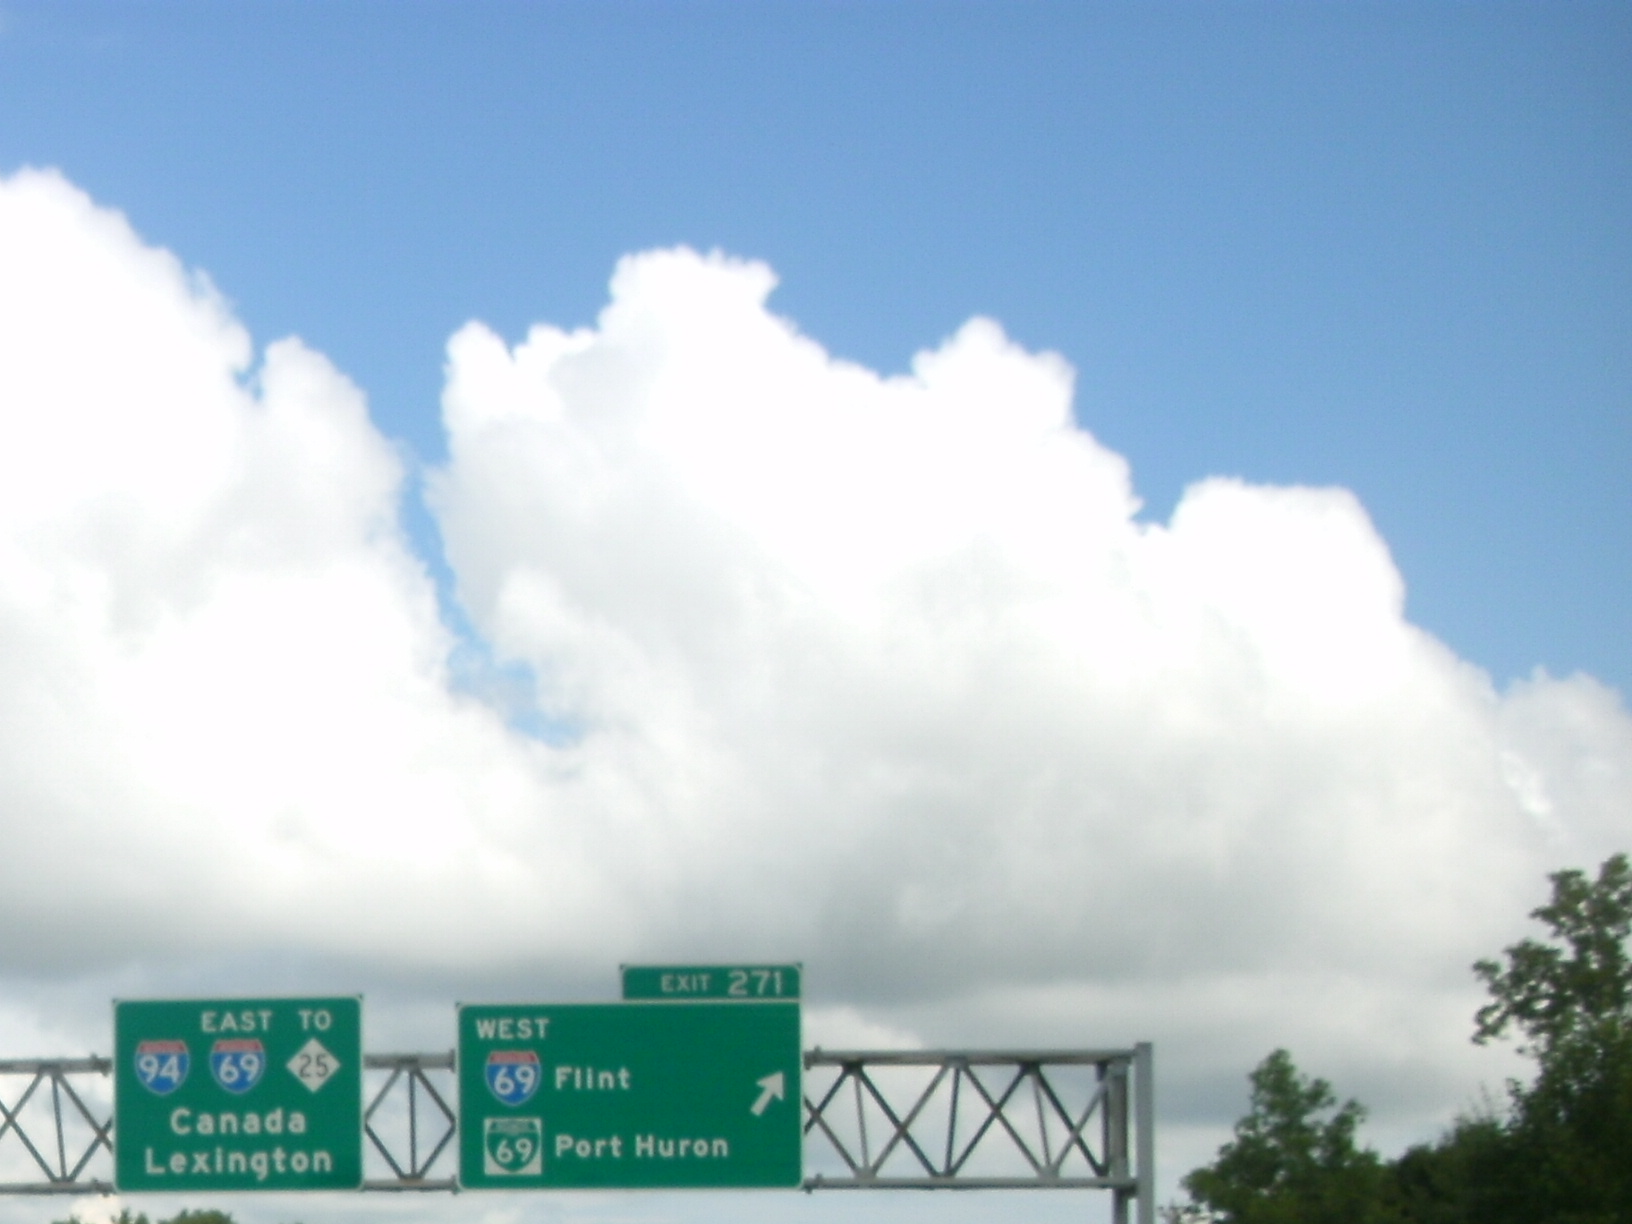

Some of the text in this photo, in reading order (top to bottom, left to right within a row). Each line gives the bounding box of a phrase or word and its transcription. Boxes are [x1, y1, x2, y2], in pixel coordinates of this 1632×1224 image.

[661, 970, 782, 995] EXIT 271
[201, 1009, 333, 1032] EAST TO
[476, 1018, 550, 1039] WEST
[139, 1053, 329, 1083] 94 69 25
[494, 1066, 631, 1095] 69 Flint
[170, 1107, 307, 1135] Canada
[496, 1134, 729, 1163] 69 Port Huron
[145, 1147, 333, 1181] Lexington
